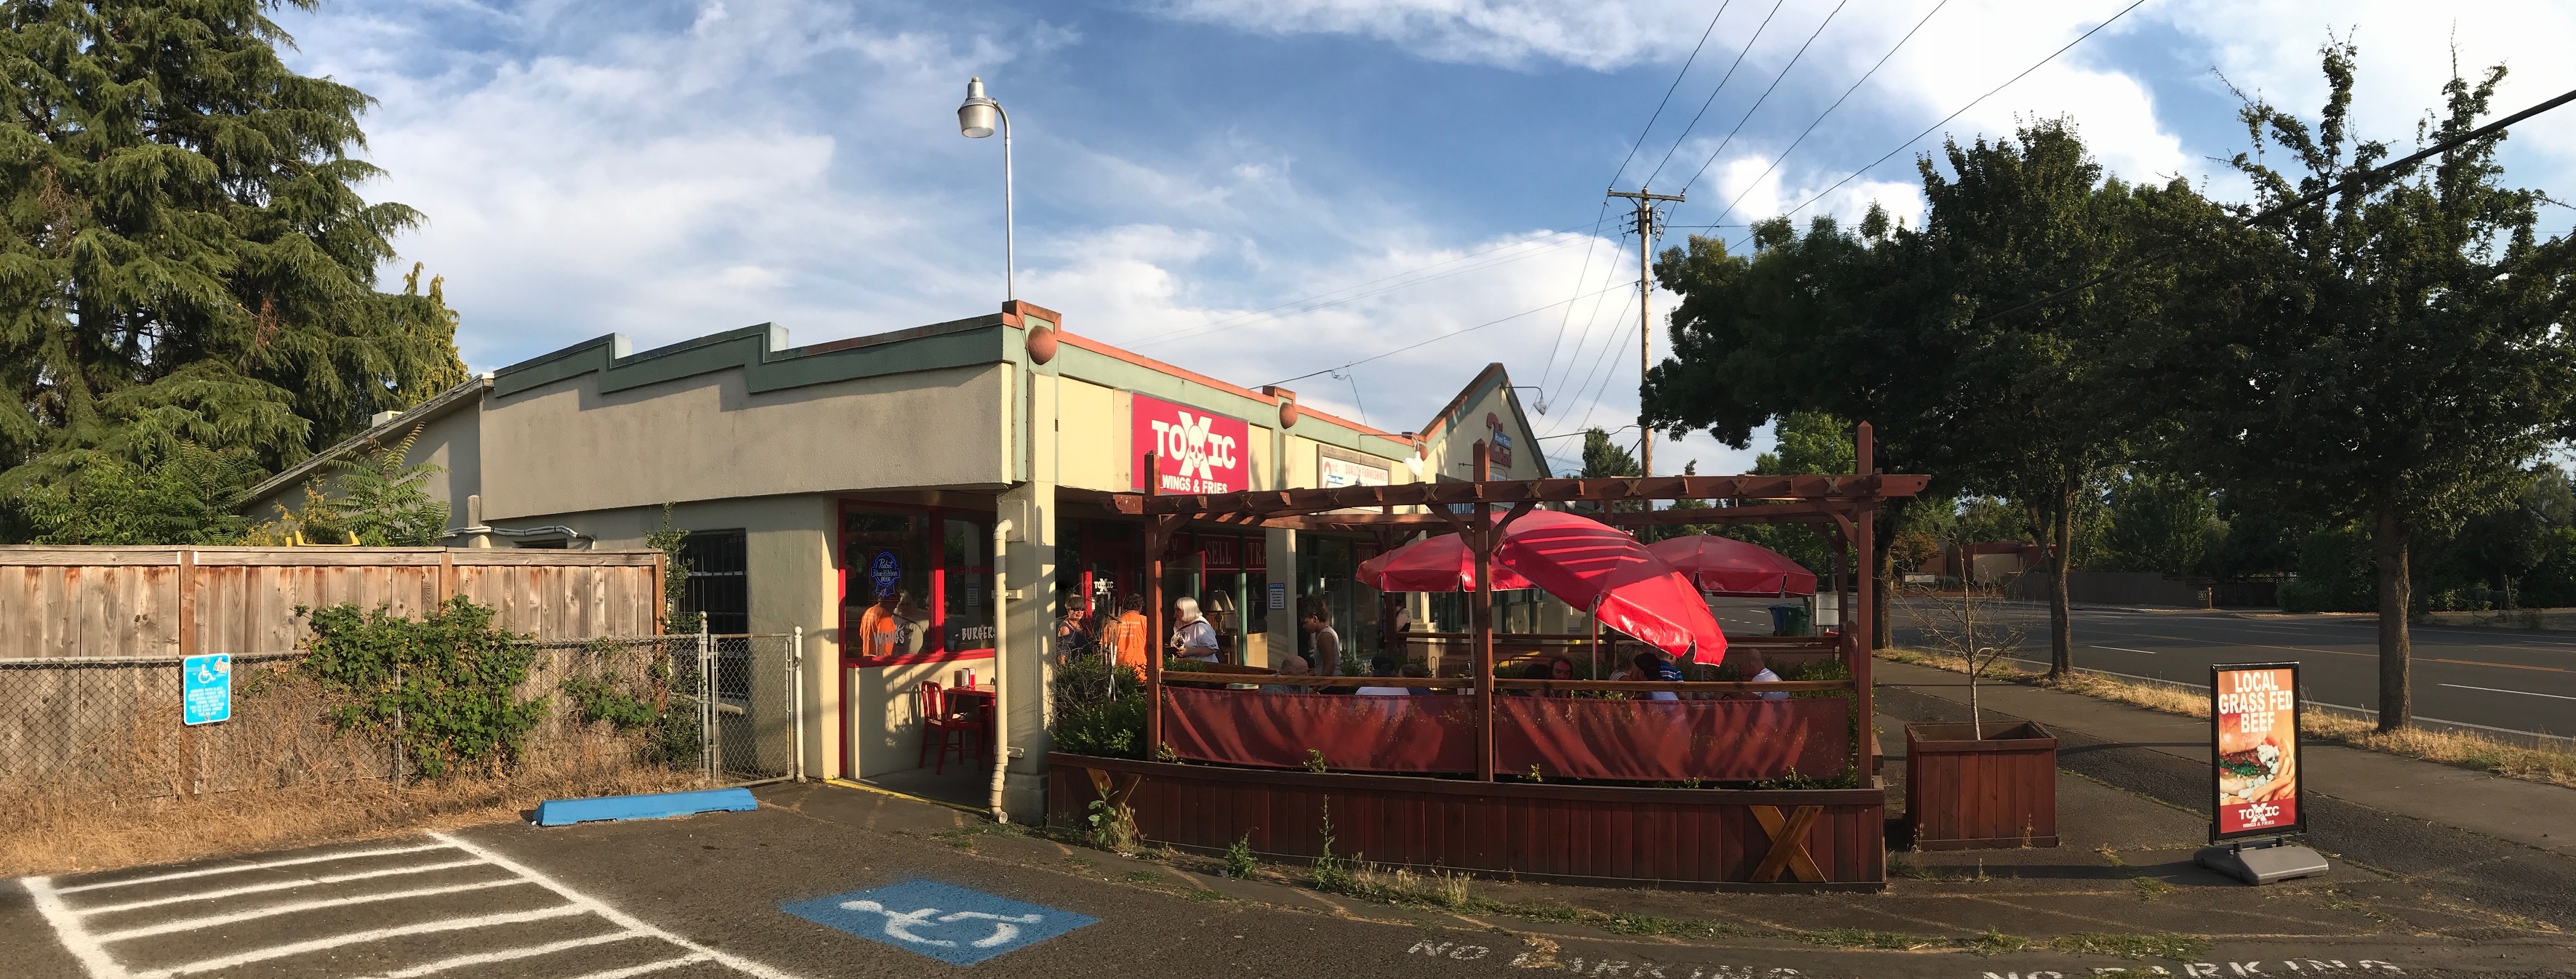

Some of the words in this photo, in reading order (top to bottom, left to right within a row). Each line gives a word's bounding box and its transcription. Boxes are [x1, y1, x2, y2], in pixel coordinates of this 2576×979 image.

[1152, 411, 1236, 480] TOXIC
[1162, 474, 1191, 492] WINGS
[1192, 478, 1200, 493] &
[1202, 480, 1227, 494] FRIES
[1205, 540, 1232, 565] SELL
[1248, 542, 1266, 565] TRA
[1094, 579, 1114, 592] TOXIC
[873, 631, 904, 645] WINGS
[2234, 671, 2279, 693] LOCAL
[2218, 691, 2266, 714] GRASS
[2269, 690, 2293, 711] FED
[2240, 711, 2275, 733] BEEF
[2239, 803, 2280, 823] TOXIC
[1408, 939, 1490, 961] NO
